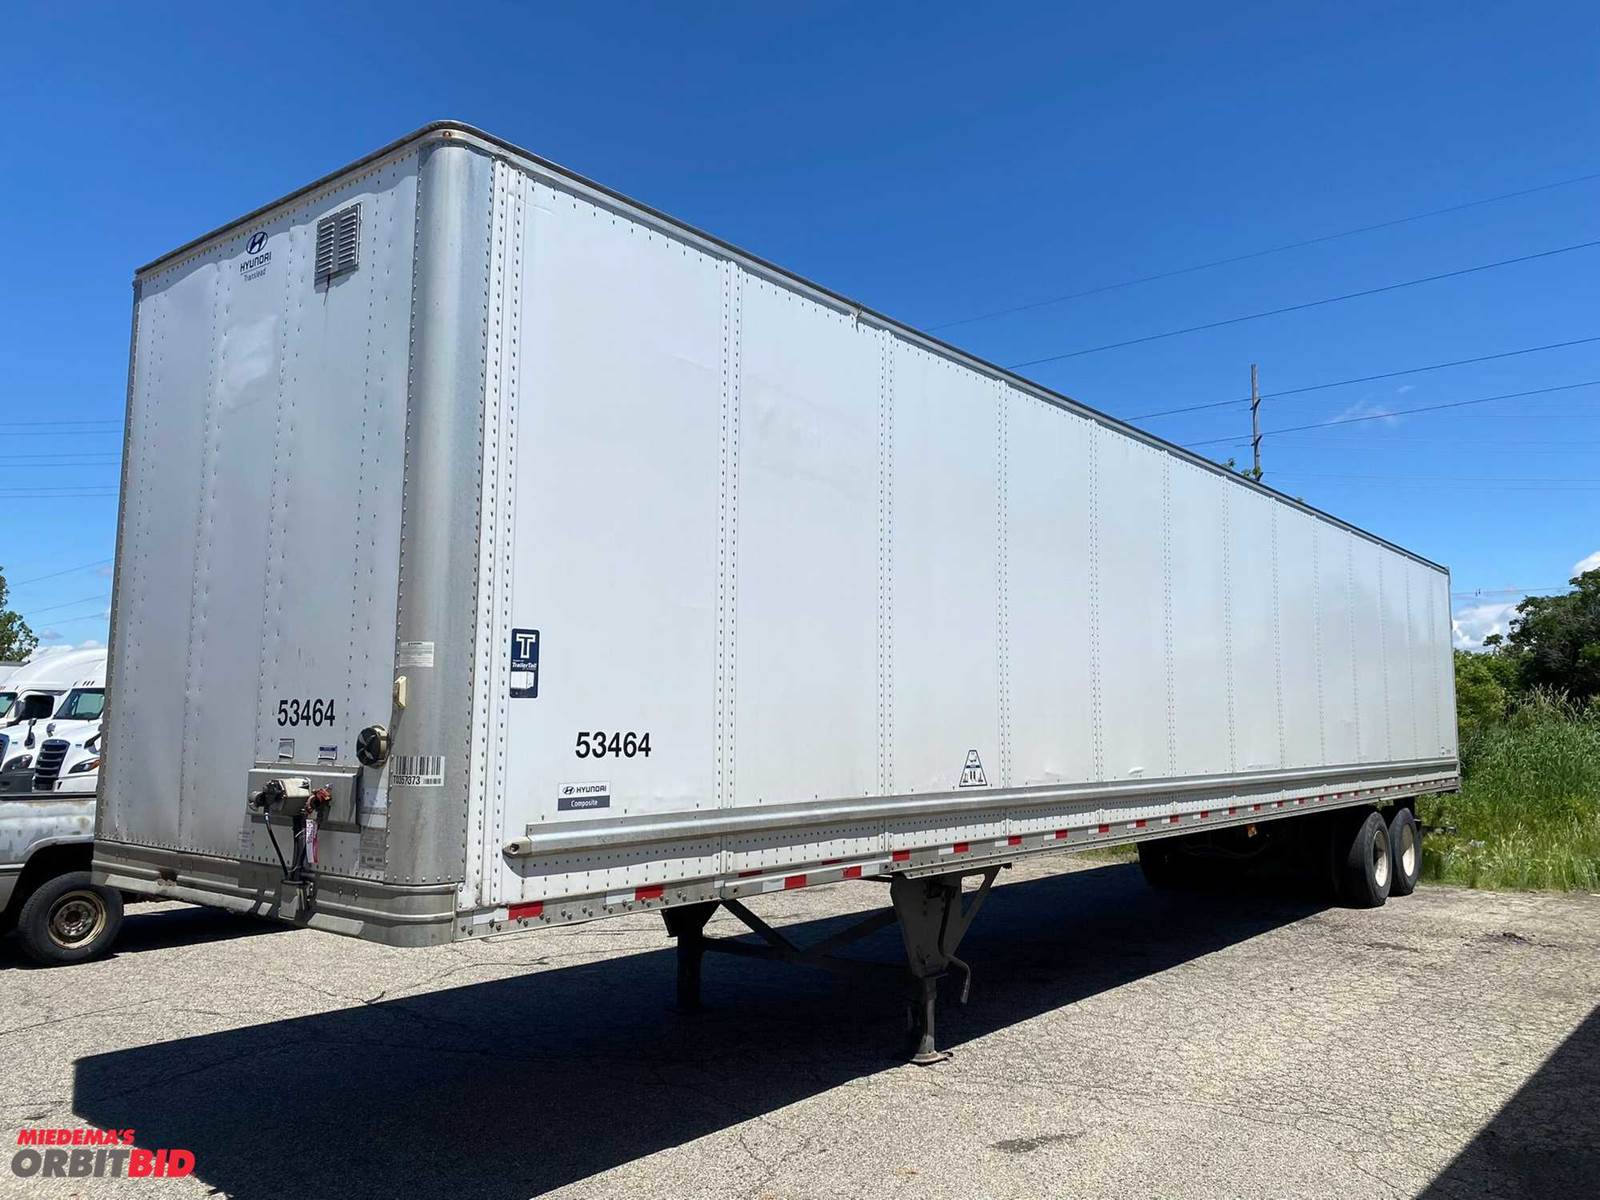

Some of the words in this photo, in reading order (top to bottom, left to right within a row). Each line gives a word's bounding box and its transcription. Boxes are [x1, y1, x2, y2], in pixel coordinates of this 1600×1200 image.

[240, 252, 271, 272] HYUNDAI
[277, 699, 336, 727] 53464
[575, 731, 651, 758] 53464
[576, 785, 607, 793] HYUNDAI
[570, 799, 598, 808] Composite
